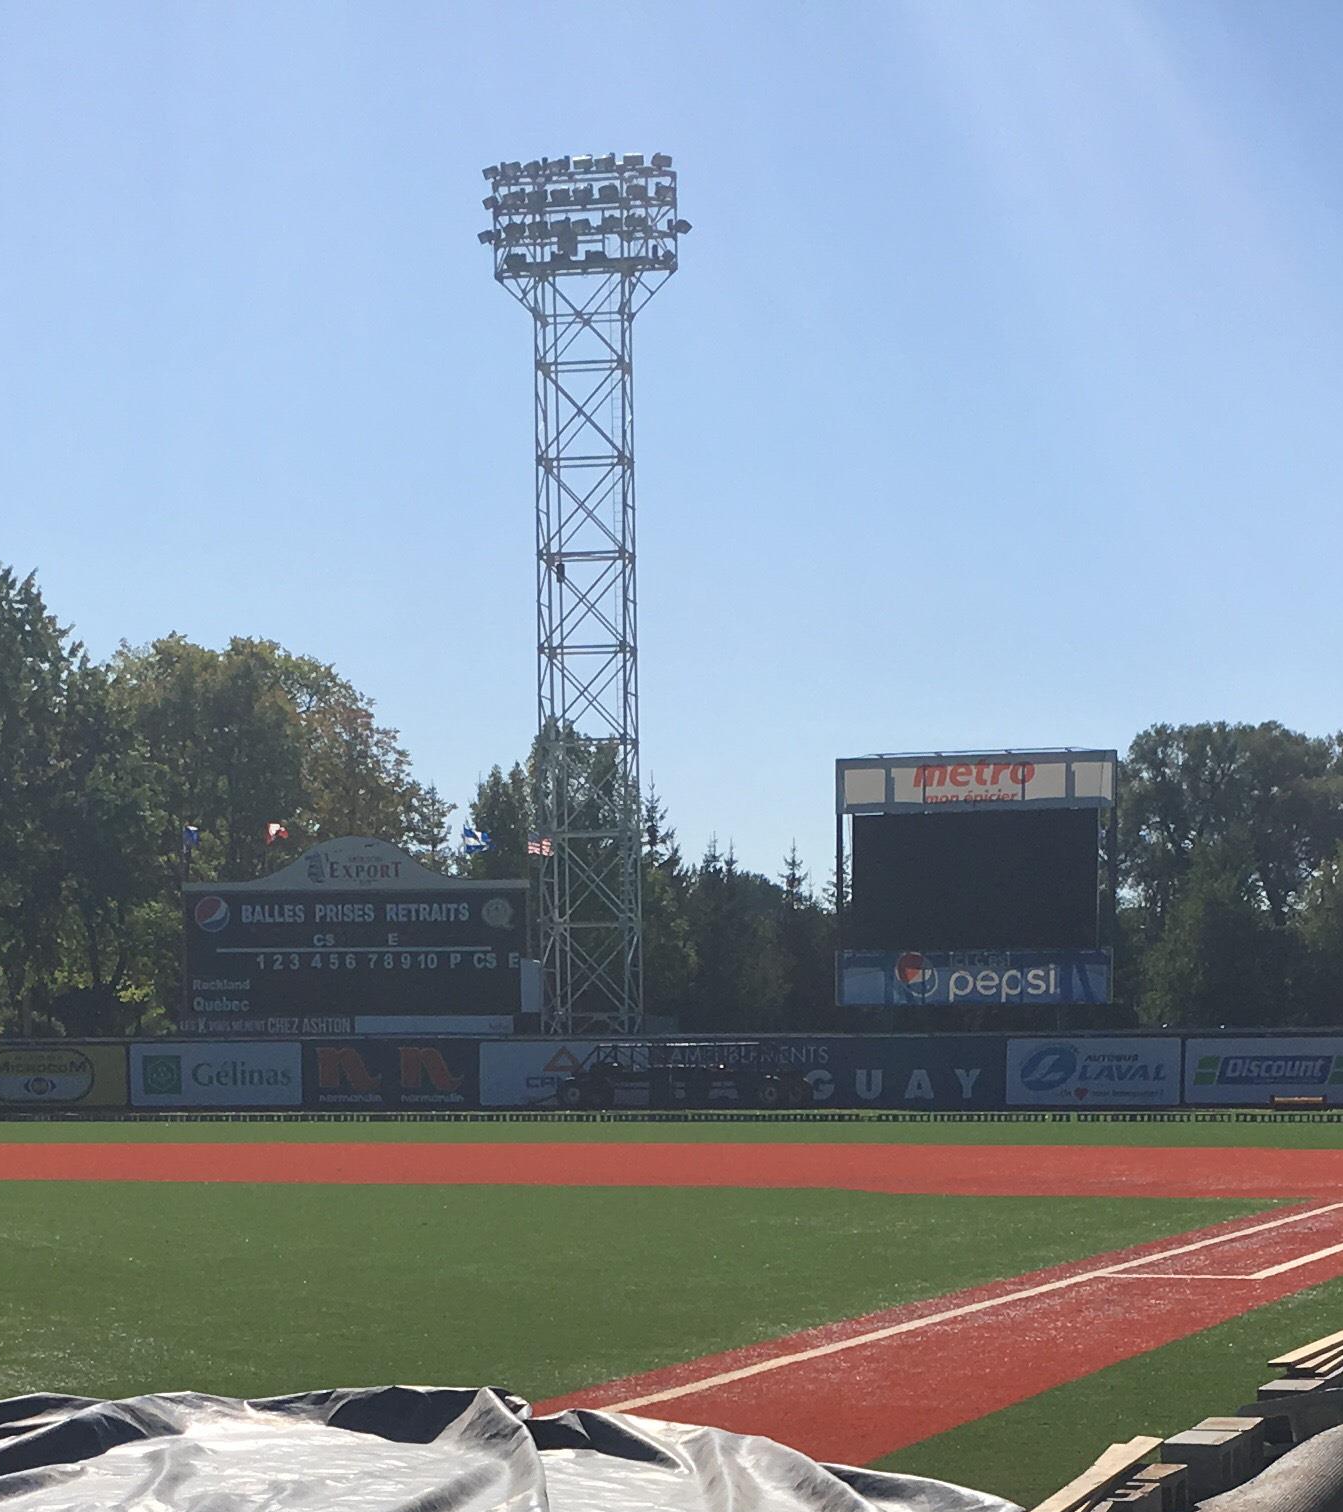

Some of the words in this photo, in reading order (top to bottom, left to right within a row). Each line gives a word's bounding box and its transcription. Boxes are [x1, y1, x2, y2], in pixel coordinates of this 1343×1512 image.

[913, 759, 1036, 788] metro
[926, 793, 959, 805] mon
[241, 904, 305, 924] BALLES
[315, 903, 375, 923] PRISES
[386, 902, 470, 922] RETRAITS
[313, 934, 335, 946] CS
[388, 933, 399, 945] E
[256, 953, 265, 970] 1
[272, 953, 284, 970] 2
[288, 953, 300, 970] 3
[310, 953, 323, 970] 4
[329, 953, 340, 970] 5
[345, 953, 357, 970] 6
[367, 953, 379, 970] 7
[384, 952, 395, 969] 8
[401, 952, 412, 969] 9
[417, 952, 438, 969] 10
[450, 952, 462, 969] P
[473, 952, 498, 969] CS
[508, 952, 519, 969] E
[949, 964, 1056, 1003] pepsi
[268, 1017, 299, 1034] CHEZ
[302, 1016, 351, 1034] ASHTON
[191, 1060, 291, 1087] Gélinas
[1078, 1063, 1167, 1081] LAVAL
